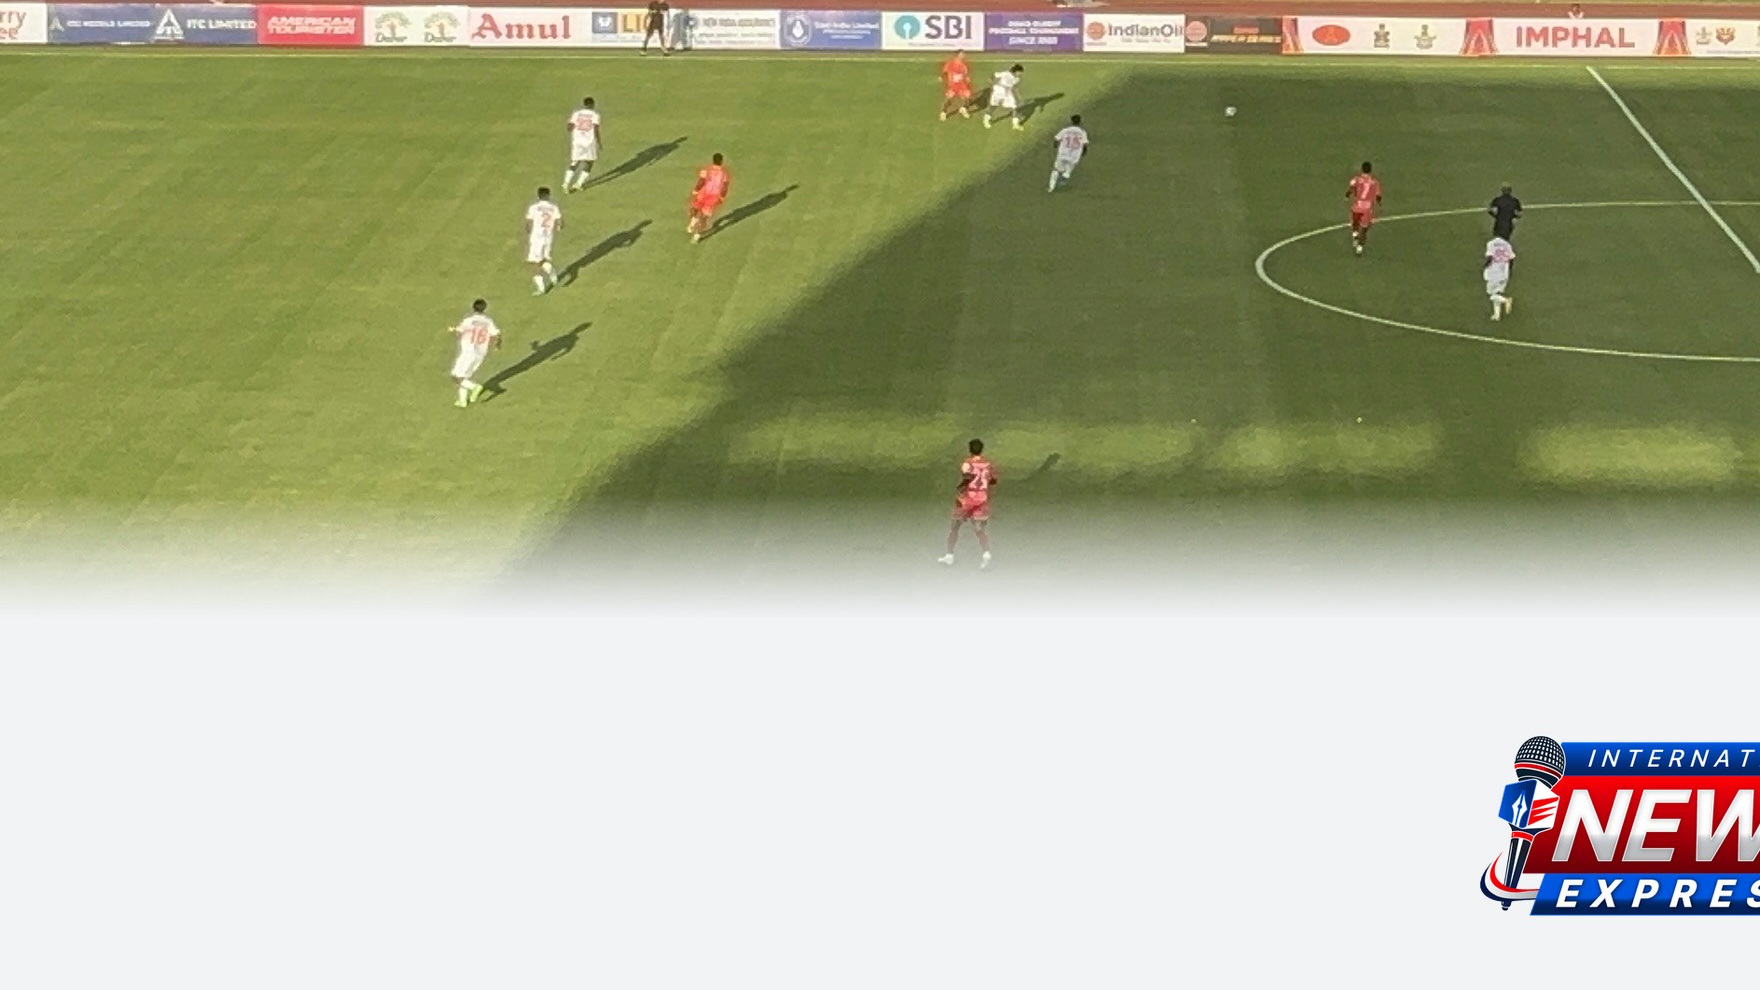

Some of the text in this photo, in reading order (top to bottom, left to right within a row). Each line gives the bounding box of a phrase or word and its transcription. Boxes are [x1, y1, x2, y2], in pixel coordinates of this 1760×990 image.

[208, 18, 257, 30] LIMITED
[268, 16, 356, 27] AMERICAN
[471, 12, 571, 40] Amul
[924, 15, 973, 40] SBI
[269, 25, 355, 35] TOURISTER
[1107, 23, 1184, 38] IndianOil
[1516, 26, 1636, 48] IMPHAL
[540, 211, 552, 228] 2
